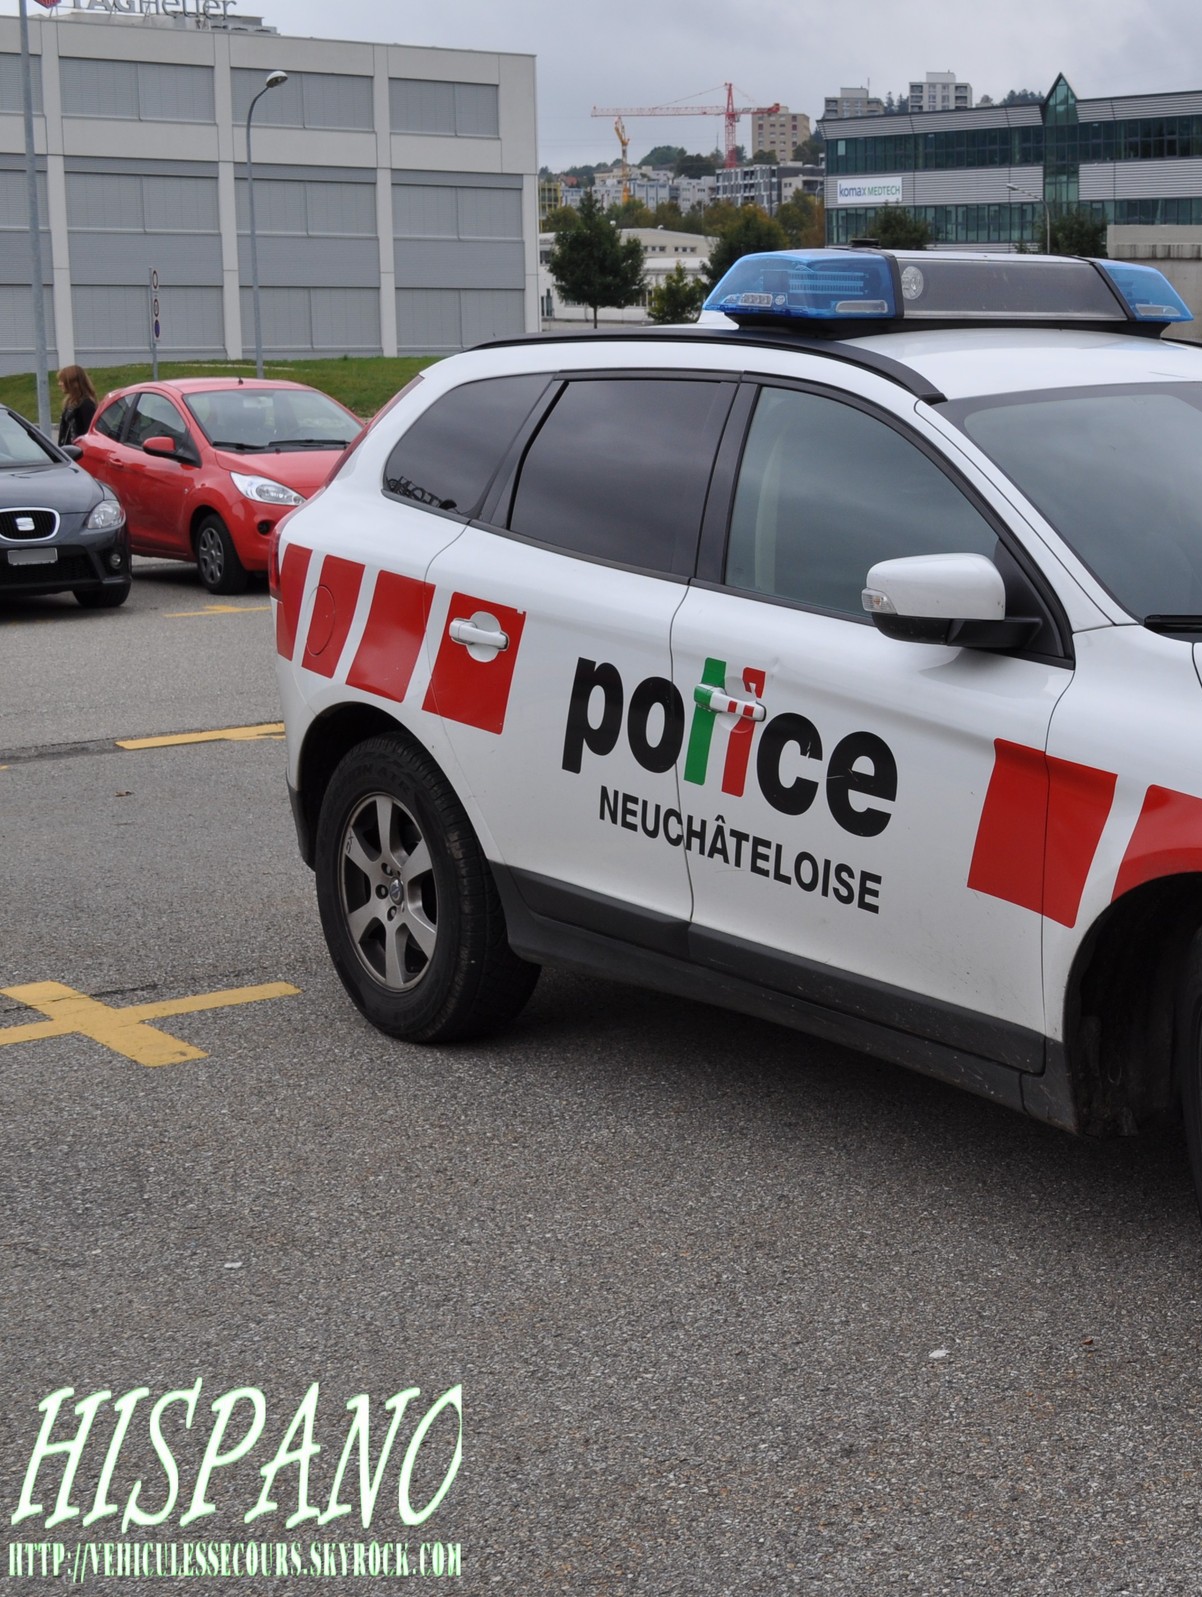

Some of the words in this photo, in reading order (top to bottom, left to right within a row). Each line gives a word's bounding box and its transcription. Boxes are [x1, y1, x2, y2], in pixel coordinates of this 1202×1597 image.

[839, 184, 866, 197] komax
[867, 185, 900, 196] MEDTECH
[561, 657, 898, 838] police
[599, 785, 883, 915] NEUCHÂTELOISE
